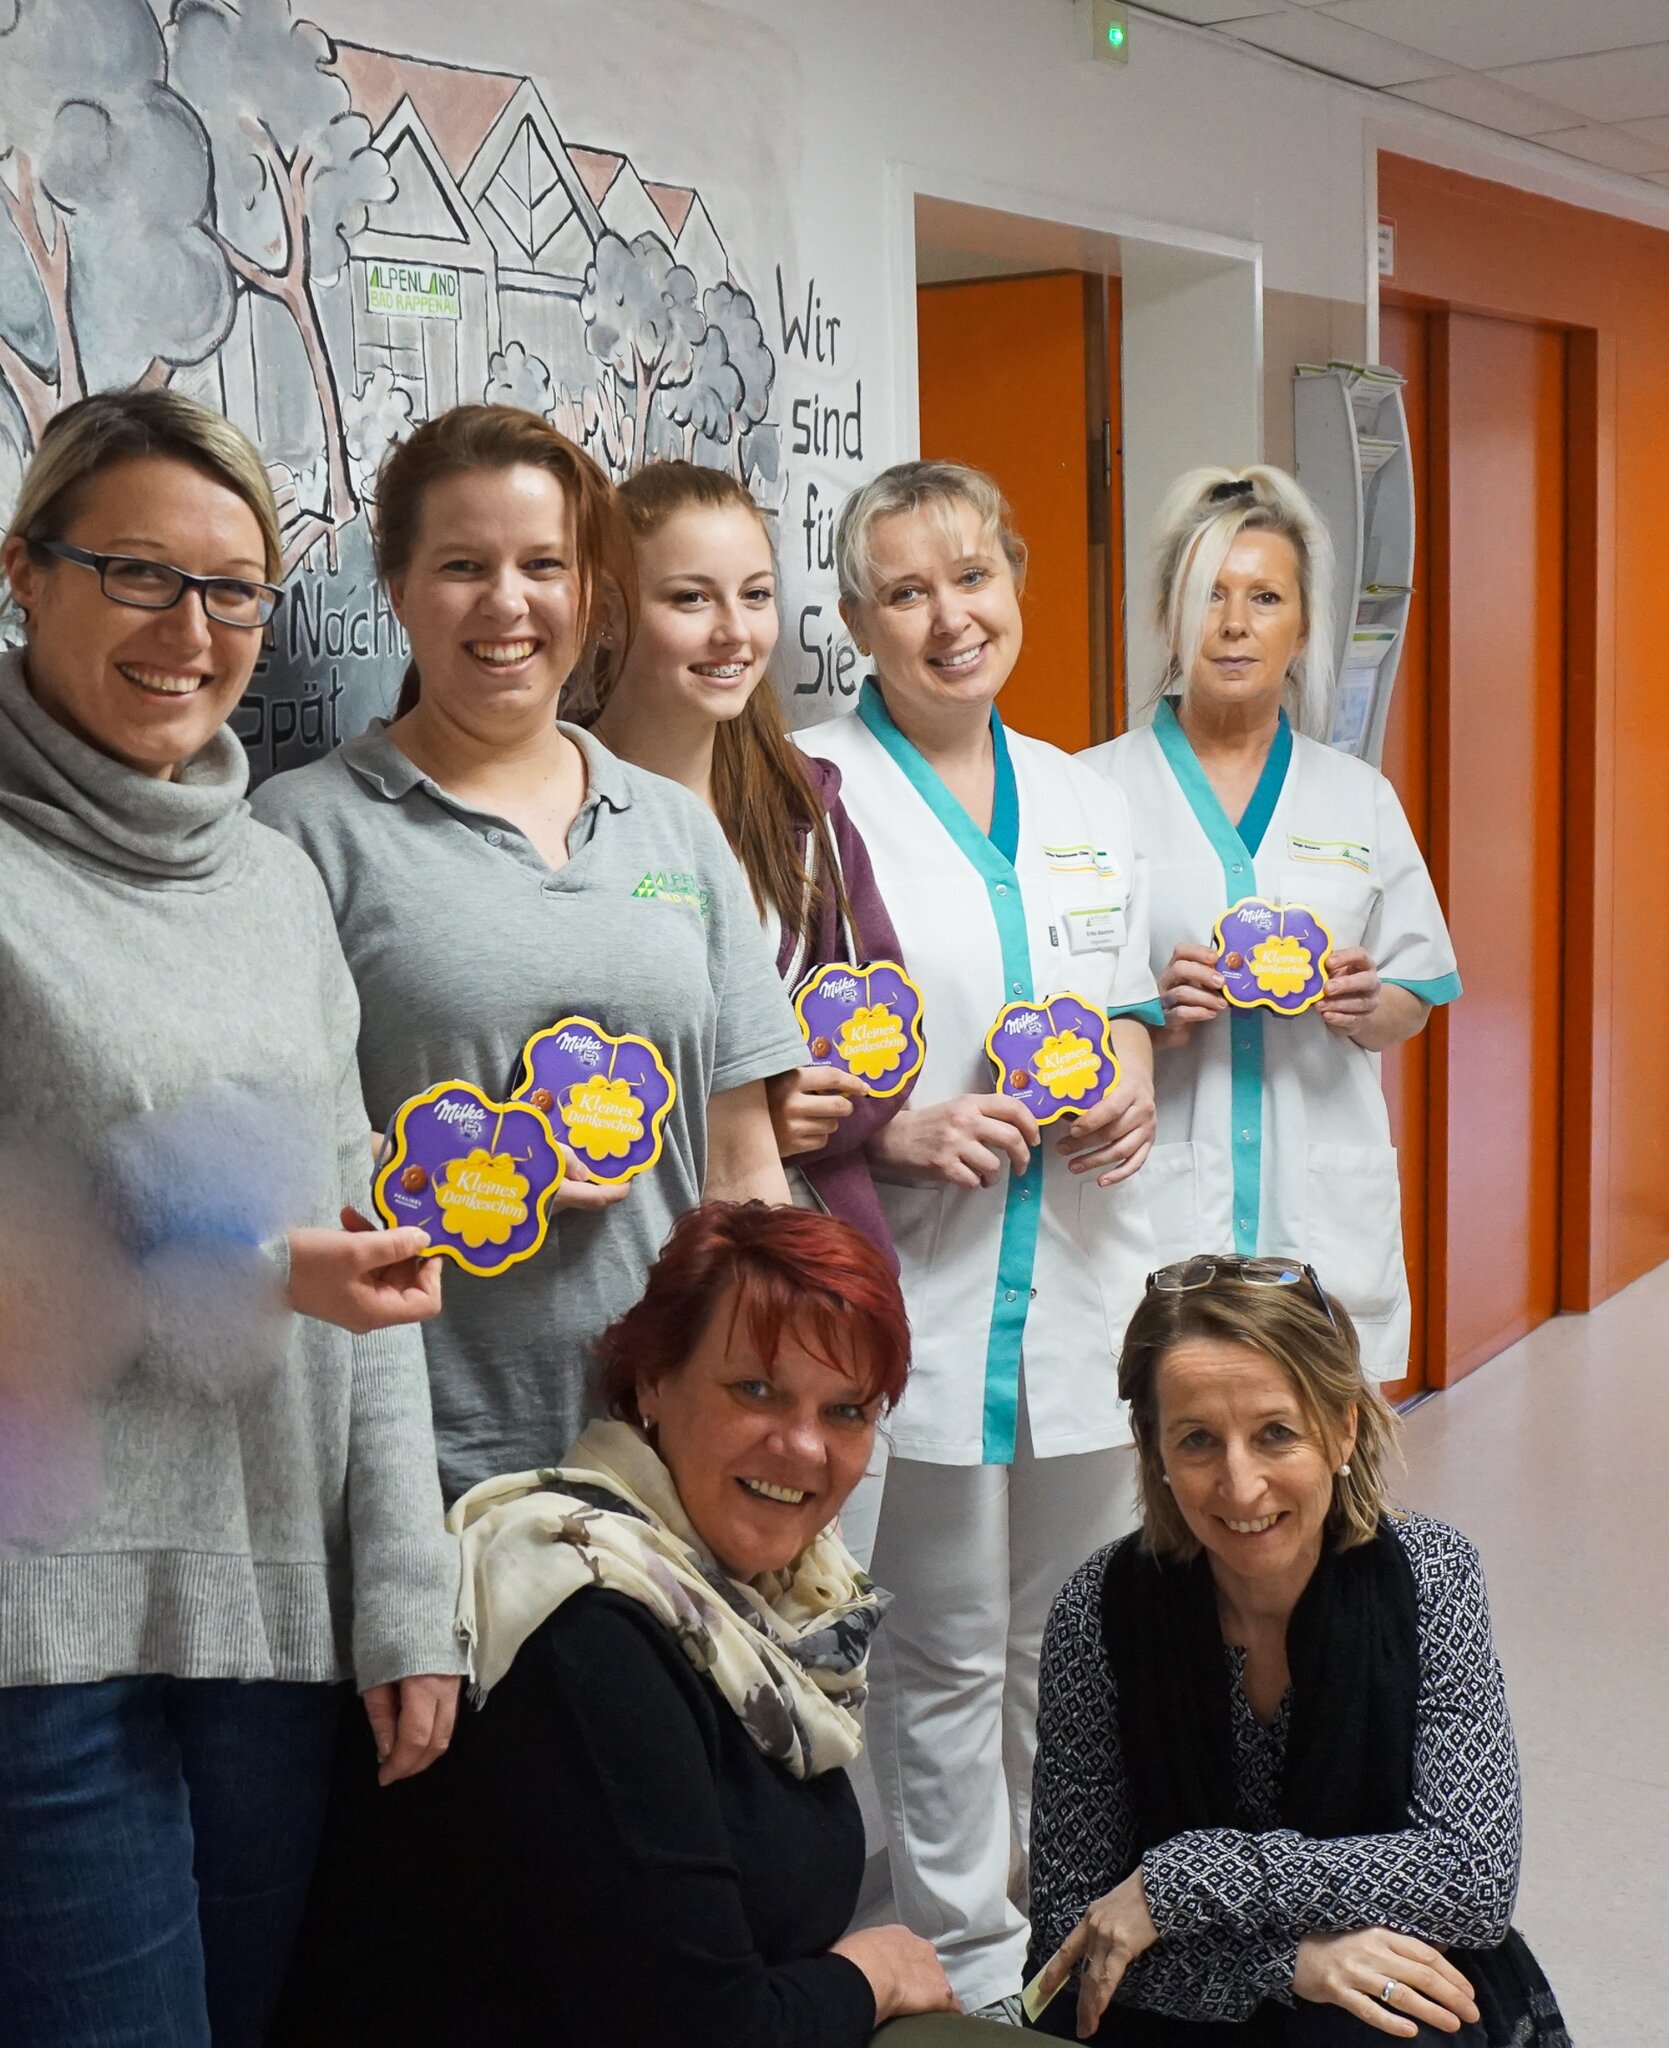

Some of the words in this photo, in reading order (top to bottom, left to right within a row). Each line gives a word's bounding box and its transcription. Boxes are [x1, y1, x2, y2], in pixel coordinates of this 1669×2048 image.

[369, 265, 456, 297] ALPENLAND
[370, 291, 393, 309] BAD
[775, 262, 842, 367] Wir
[791, 379, 864, 462] sind
[802, 482, 836, 573] fü
[794, 604, 858, 697] Sie
[1237, 908, 1274, 924] Milka
[818, 976, 858, 999] Milka
[1004, 1011, 1040, 1036] Milka
[555, 1031, 604, 1054] Milka
[433, 1098, 488, 1125] Milka
[579, 1094, 635, 1119] Kleines
[456, 1169, 519, 1199] Kleines
